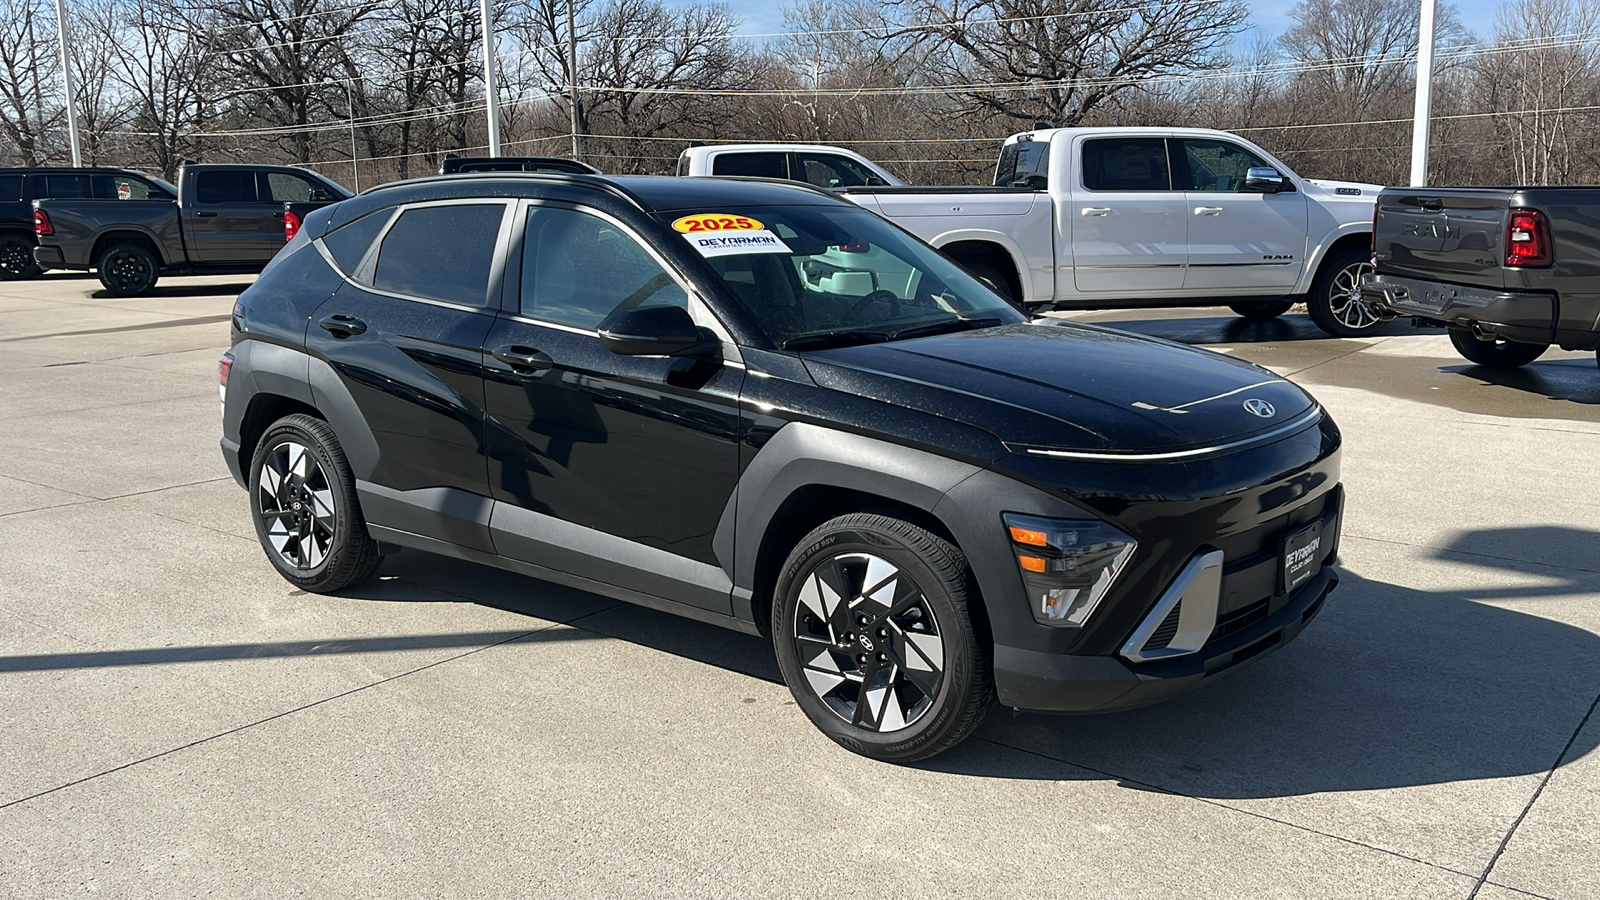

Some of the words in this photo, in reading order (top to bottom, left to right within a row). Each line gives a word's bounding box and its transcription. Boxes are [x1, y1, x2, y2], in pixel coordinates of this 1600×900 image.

[685, 218, 753, 232] 2025
[698, 237, 776, 247] DEYARMAN
[806, 543, 820, 556] R18
[821, 536, 836, 547] 95V
